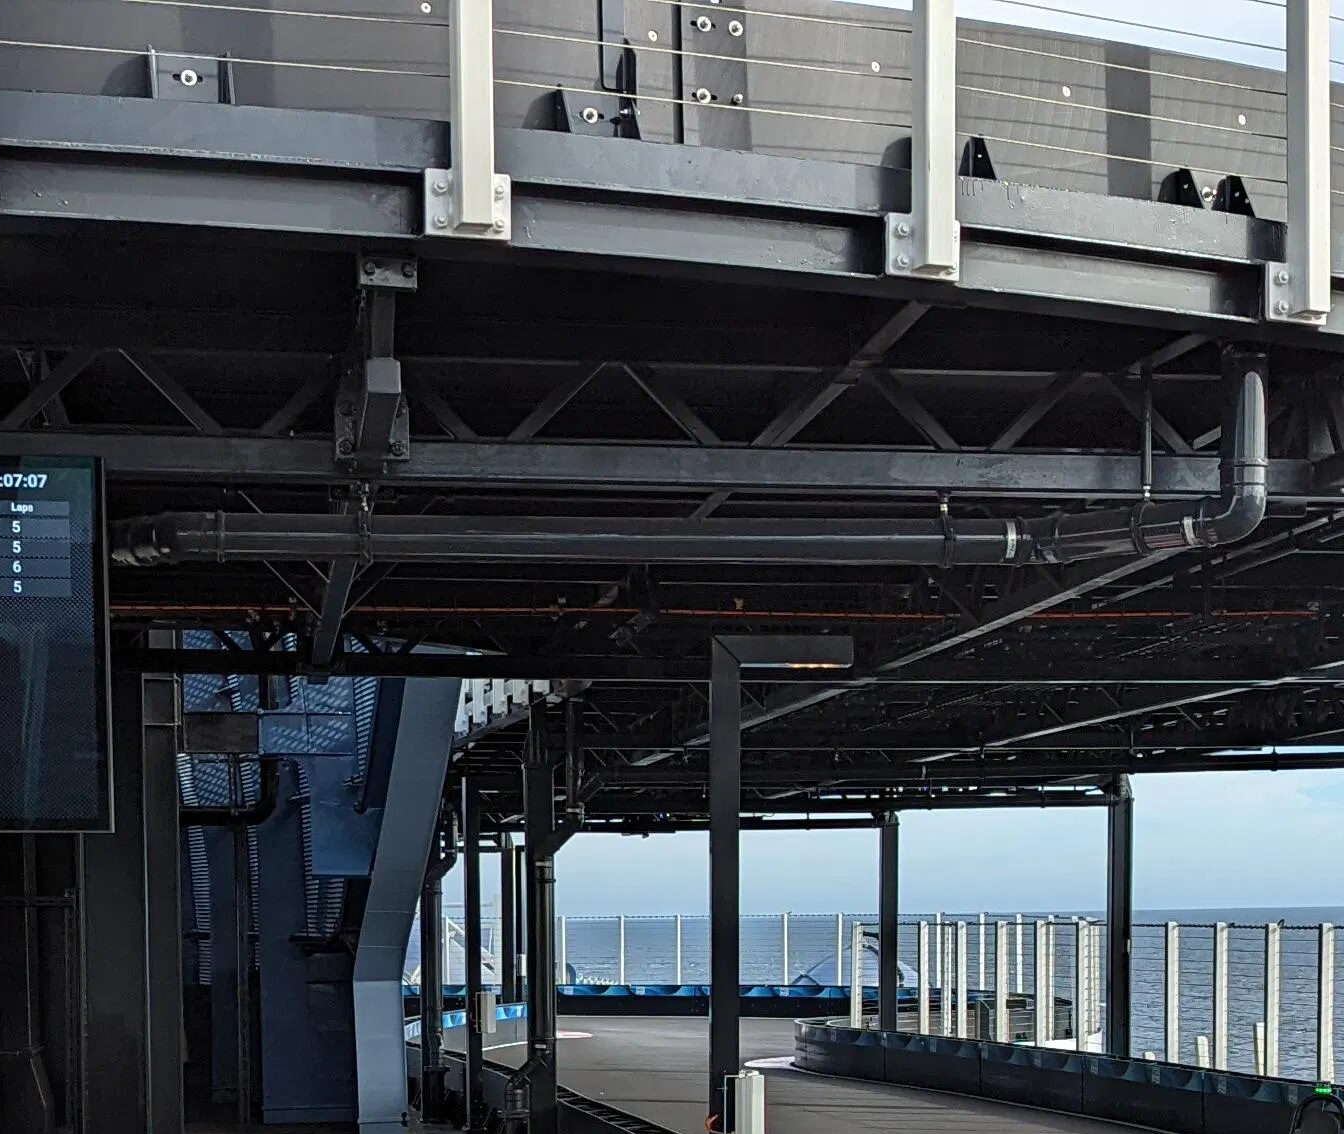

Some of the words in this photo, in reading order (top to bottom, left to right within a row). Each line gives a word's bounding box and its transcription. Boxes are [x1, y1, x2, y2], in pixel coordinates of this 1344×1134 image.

[10, 502, 34, 514] Laps
[11, 520, 21, 533] 5
[12, 540, 22, 553] 5
[12, 560, 22, 573] 6
[13, 580, 22, 593] 5
